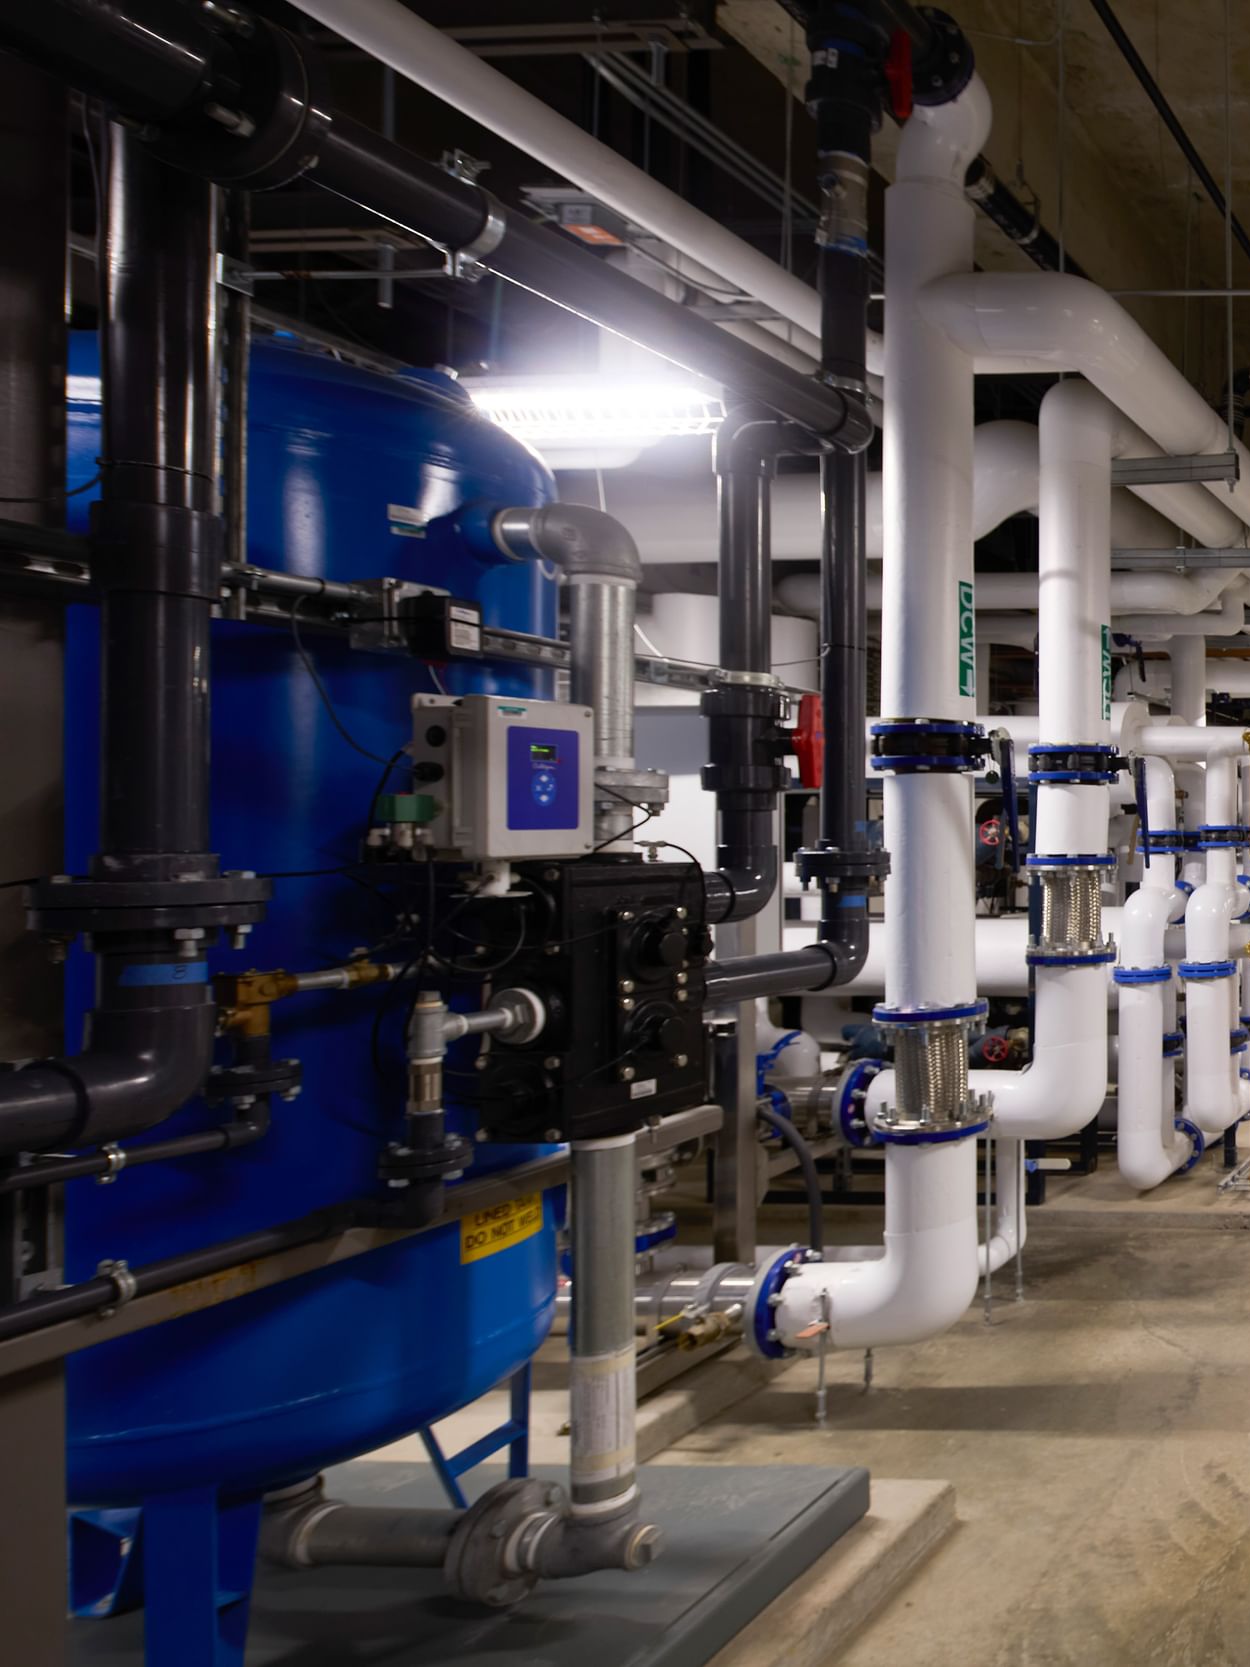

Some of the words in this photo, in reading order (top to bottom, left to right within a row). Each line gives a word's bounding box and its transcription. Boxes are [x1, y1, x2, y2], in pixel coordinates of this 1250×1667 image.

[960, 585, 975, 669] DCW
[465, 1231, 488, 1249] DO
[491, 1218, 515, 1238] NOT
